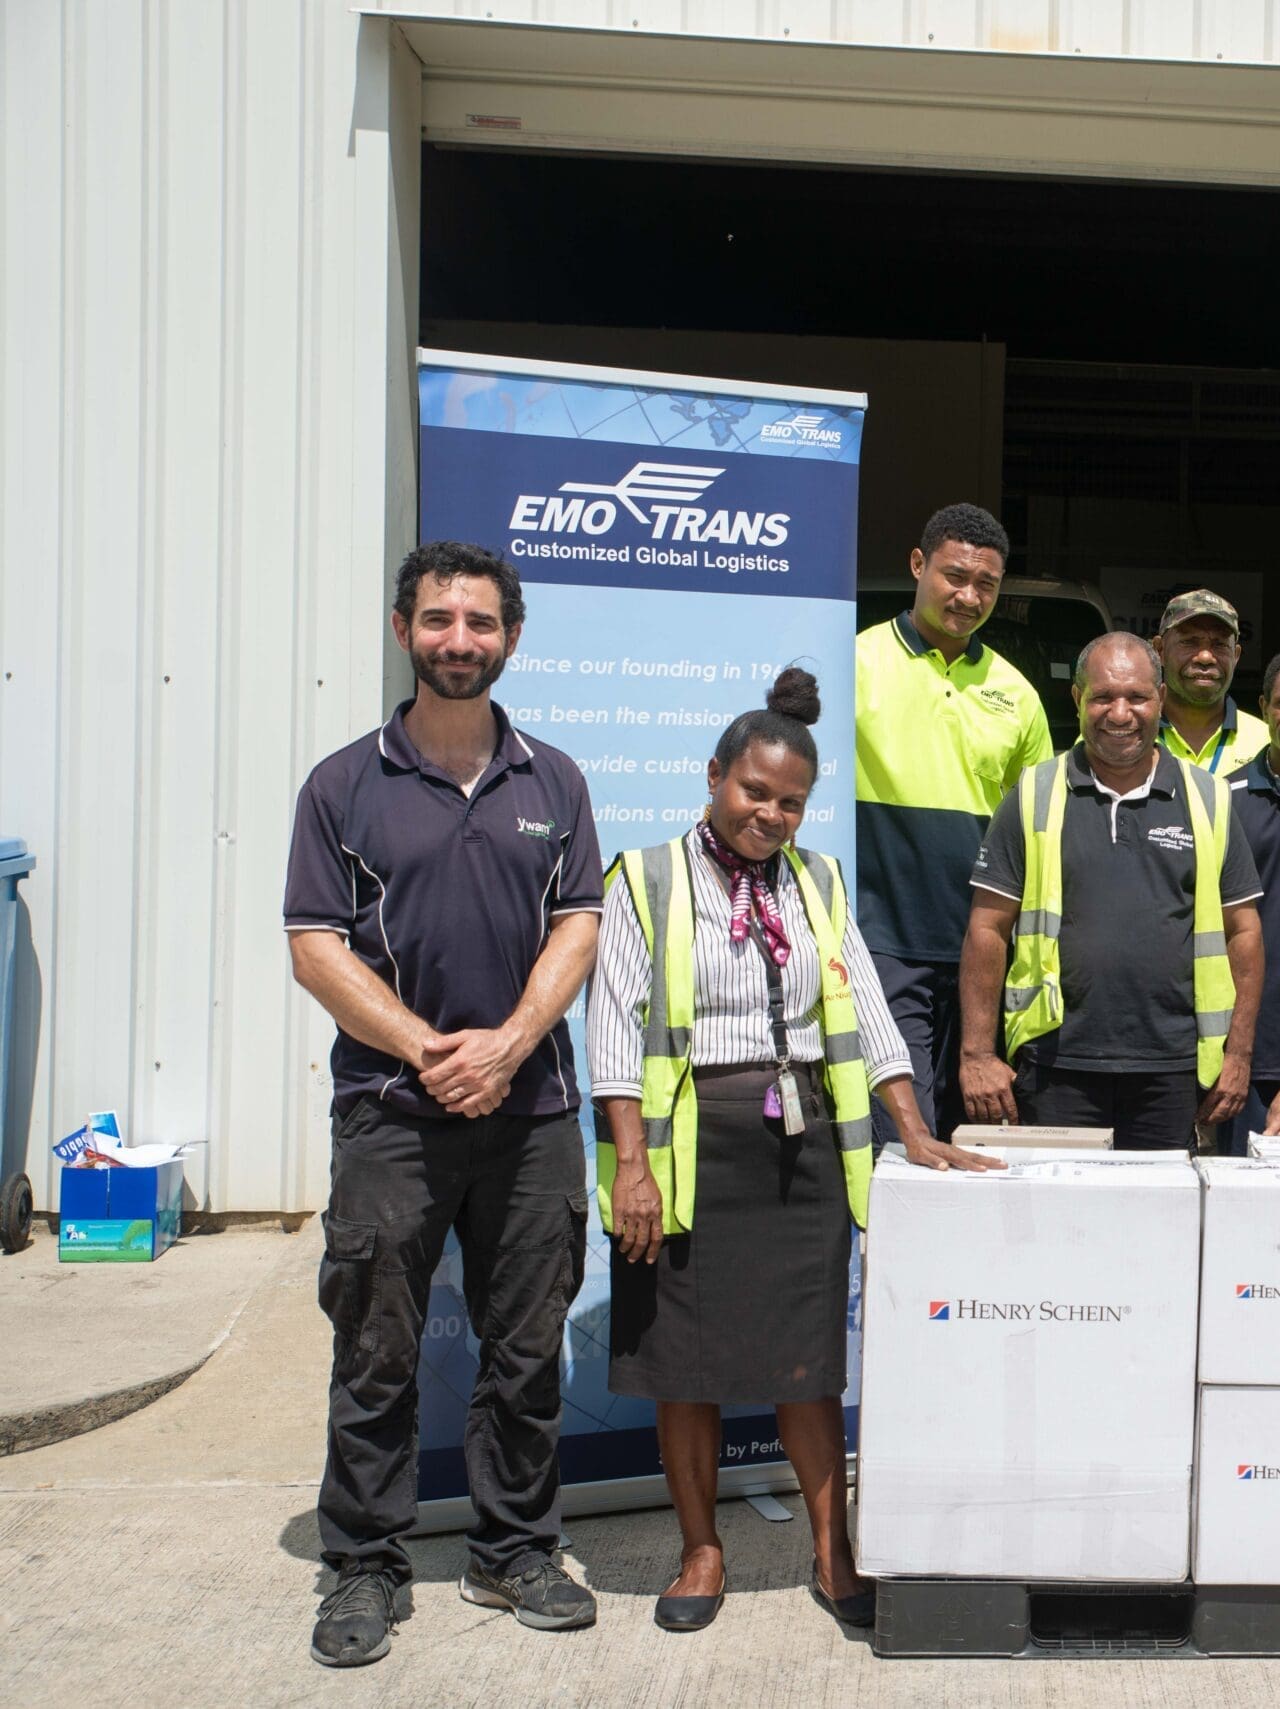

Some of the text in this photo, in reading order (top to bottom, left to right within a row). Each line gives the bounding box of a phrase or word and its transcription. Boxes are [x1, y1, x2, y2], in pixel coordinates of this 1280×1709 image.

[761, 425, 842, 443] EMO TRANS
[508, 495, 791, 547] EMO TRANS
[511, 539, 790, 573] Customized Global Logistics
[509, 653, 790, 682] Since our founding in 196
[550, 704, 608, 725] been
[616, 705, 650, 725] the
[657, 707, 736, 726] mission
[577, 755, 709, 774] ovide custo
[592, 803, 705, 822] utions and
[517, 817, 550, 835] ywam
[957, 1299, 1036, 1320] HENRY
[727, 1443, 747, 1459] by
